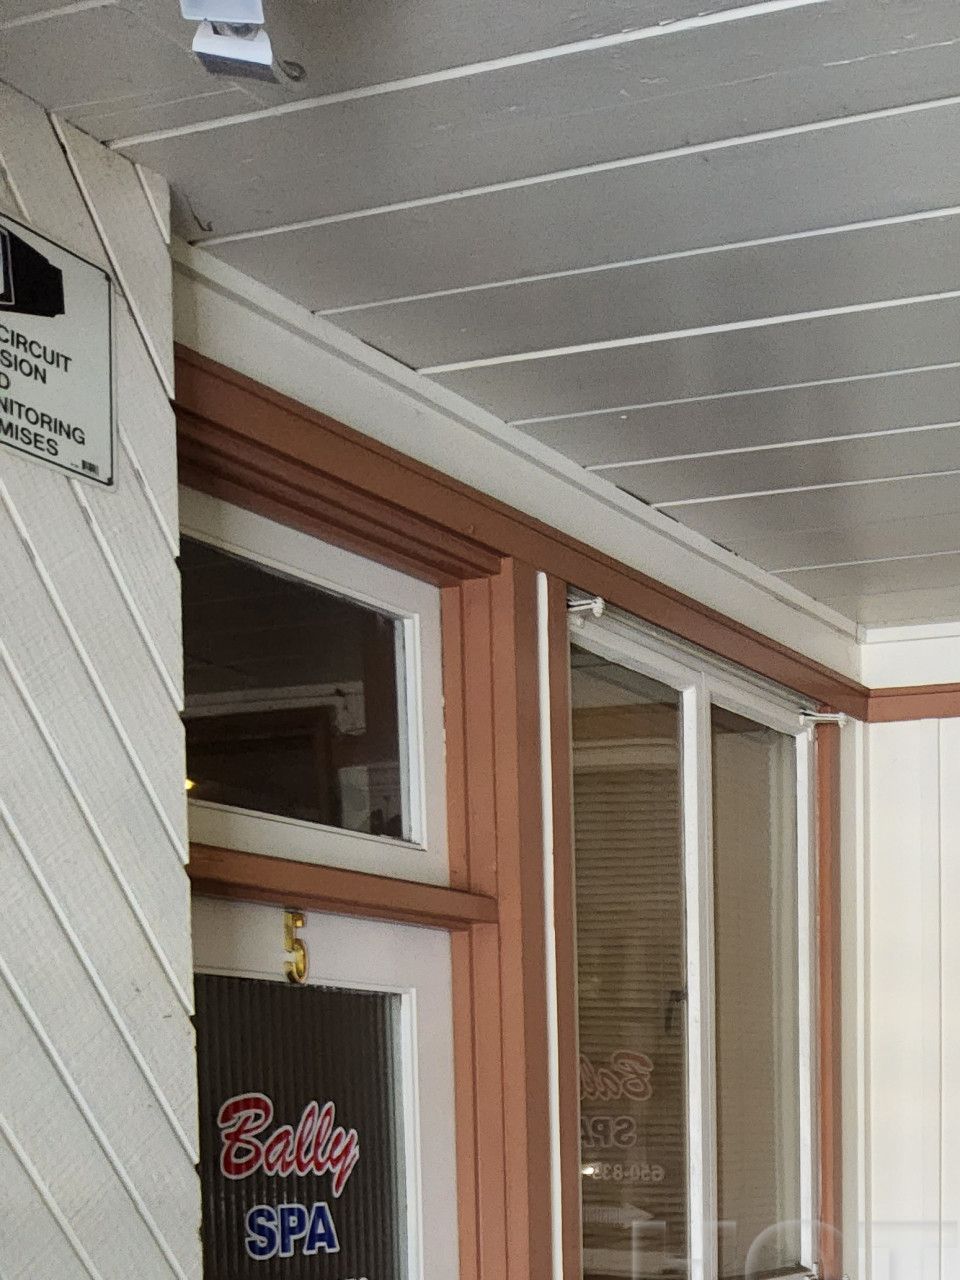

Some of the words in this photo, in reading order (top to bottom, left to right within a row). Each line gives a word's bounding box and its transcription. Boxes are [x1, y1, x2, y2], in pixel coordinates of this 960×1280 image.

[0, 324, 72, 373] CIRCUIT
[284, 911, 308, 983] 5
[217, 1092, 360, 1198] Bally
[245, 1201, 341, 1260] SPA
